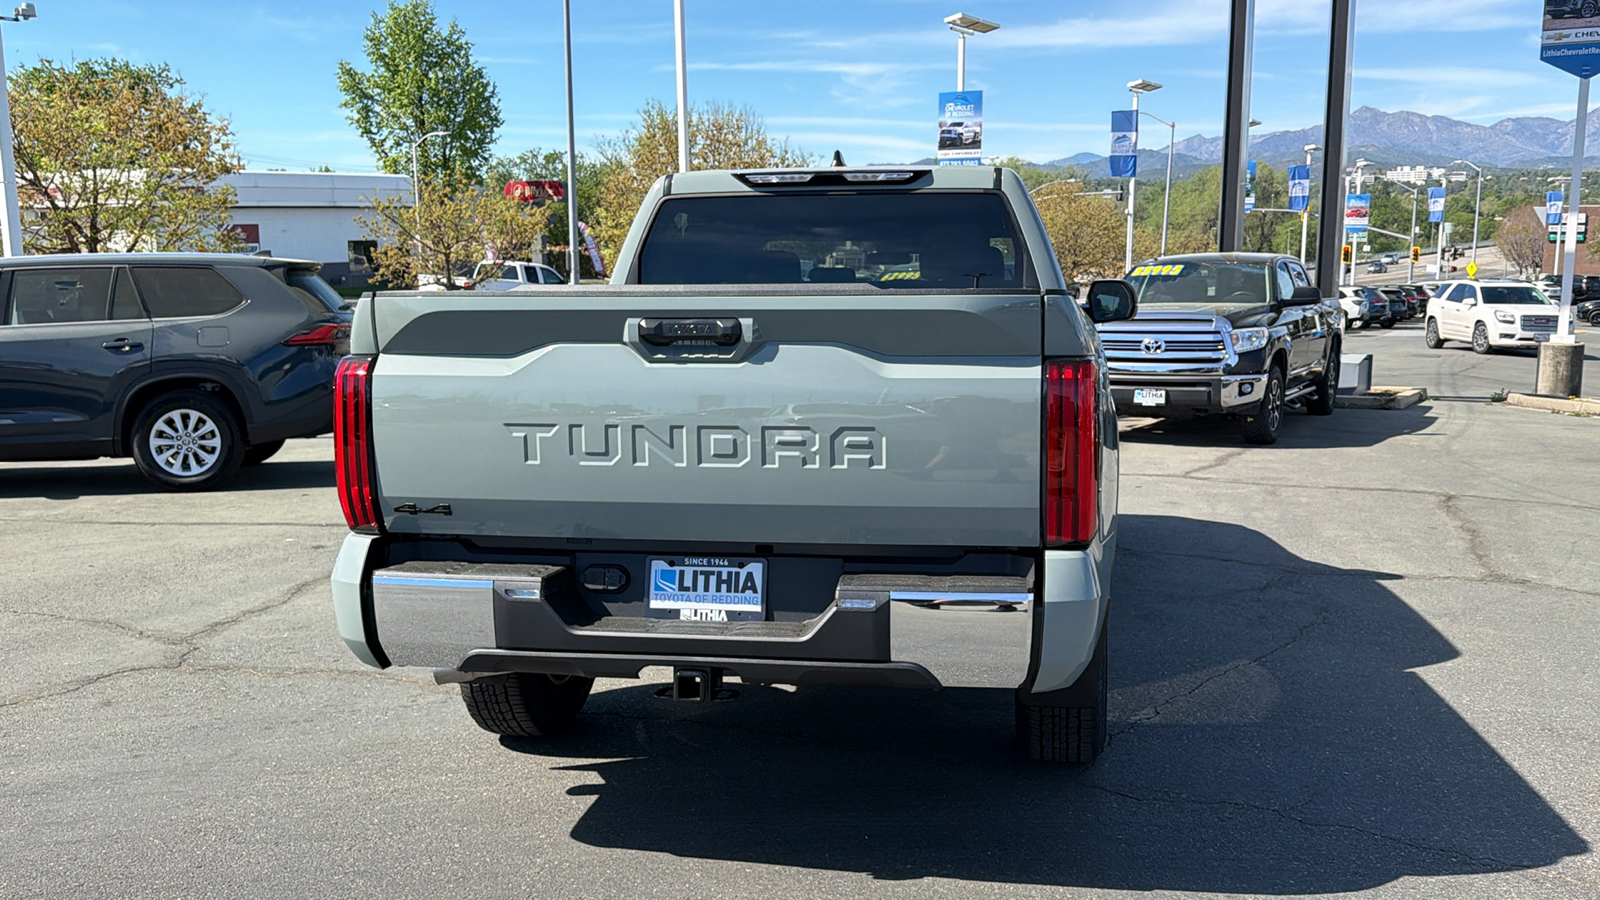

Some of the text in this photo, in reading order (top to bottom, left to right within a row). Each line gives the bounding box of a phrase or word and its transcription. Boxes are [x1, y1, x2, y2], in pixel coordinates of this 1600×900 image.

[945, 104, 974, 112] CHEVROLET
[666, 324, 714, 334] TOYOTA
[503, 423, 888, 469] TUNDRA
[684, 557, 729, 566] SINCE 1946
[678, 569, 758, 594] LITHIA
[653, 593, 759, 605] TOYOTA OF REDDING
[692, 608, 728, 621] LITHIA
